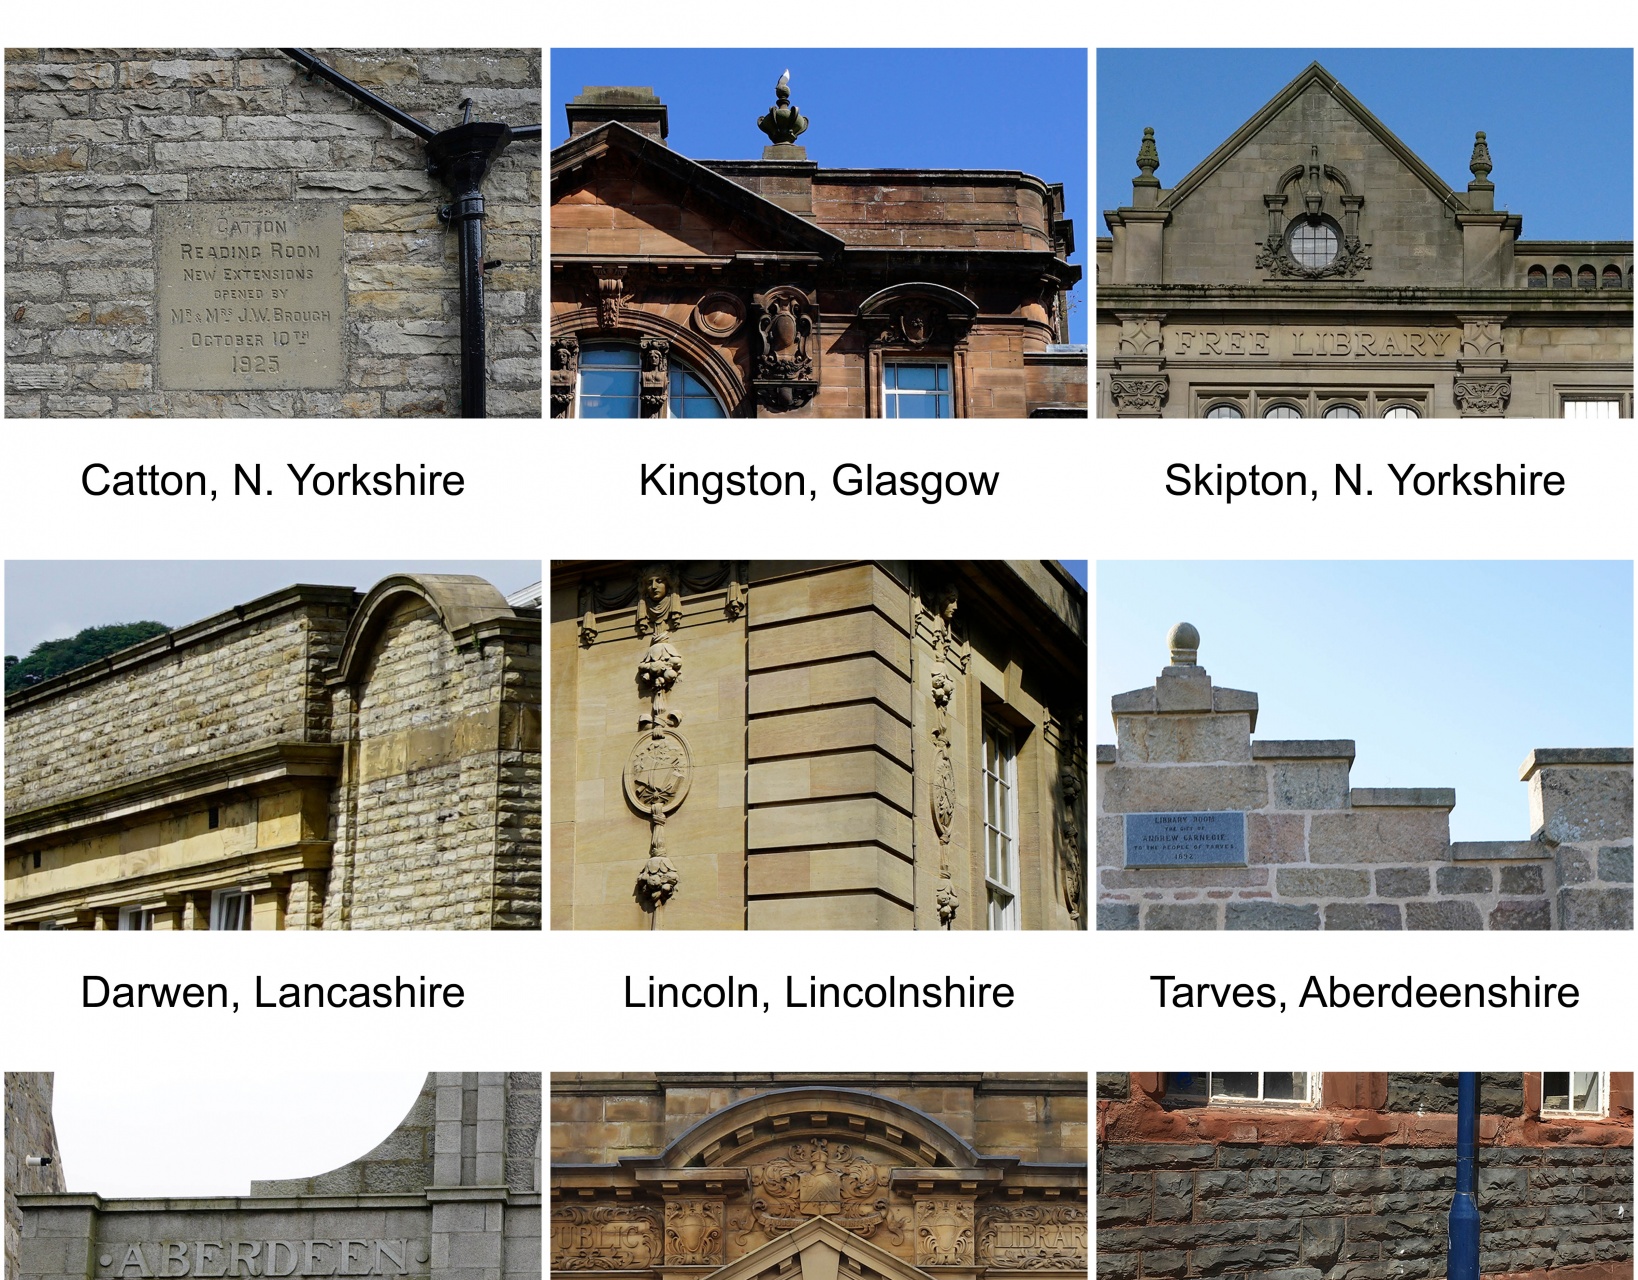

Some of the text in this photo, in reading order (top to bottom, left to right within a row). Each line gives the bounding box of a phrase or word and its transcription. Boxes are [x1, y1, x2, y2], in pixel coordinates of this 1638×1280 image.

[214, 288, 288, 300] OPENED BY
[1175, 329, 1450, 357] FREE LIBRARY
[232, 355, 280, 374] 1925
[1154, 815, 1215, 824] LIBRARY ROOM
[1142, 833, 1225, 843] ANDREW CARNEGIE
[113, 1238, 409, 1279] ABERDEEN
